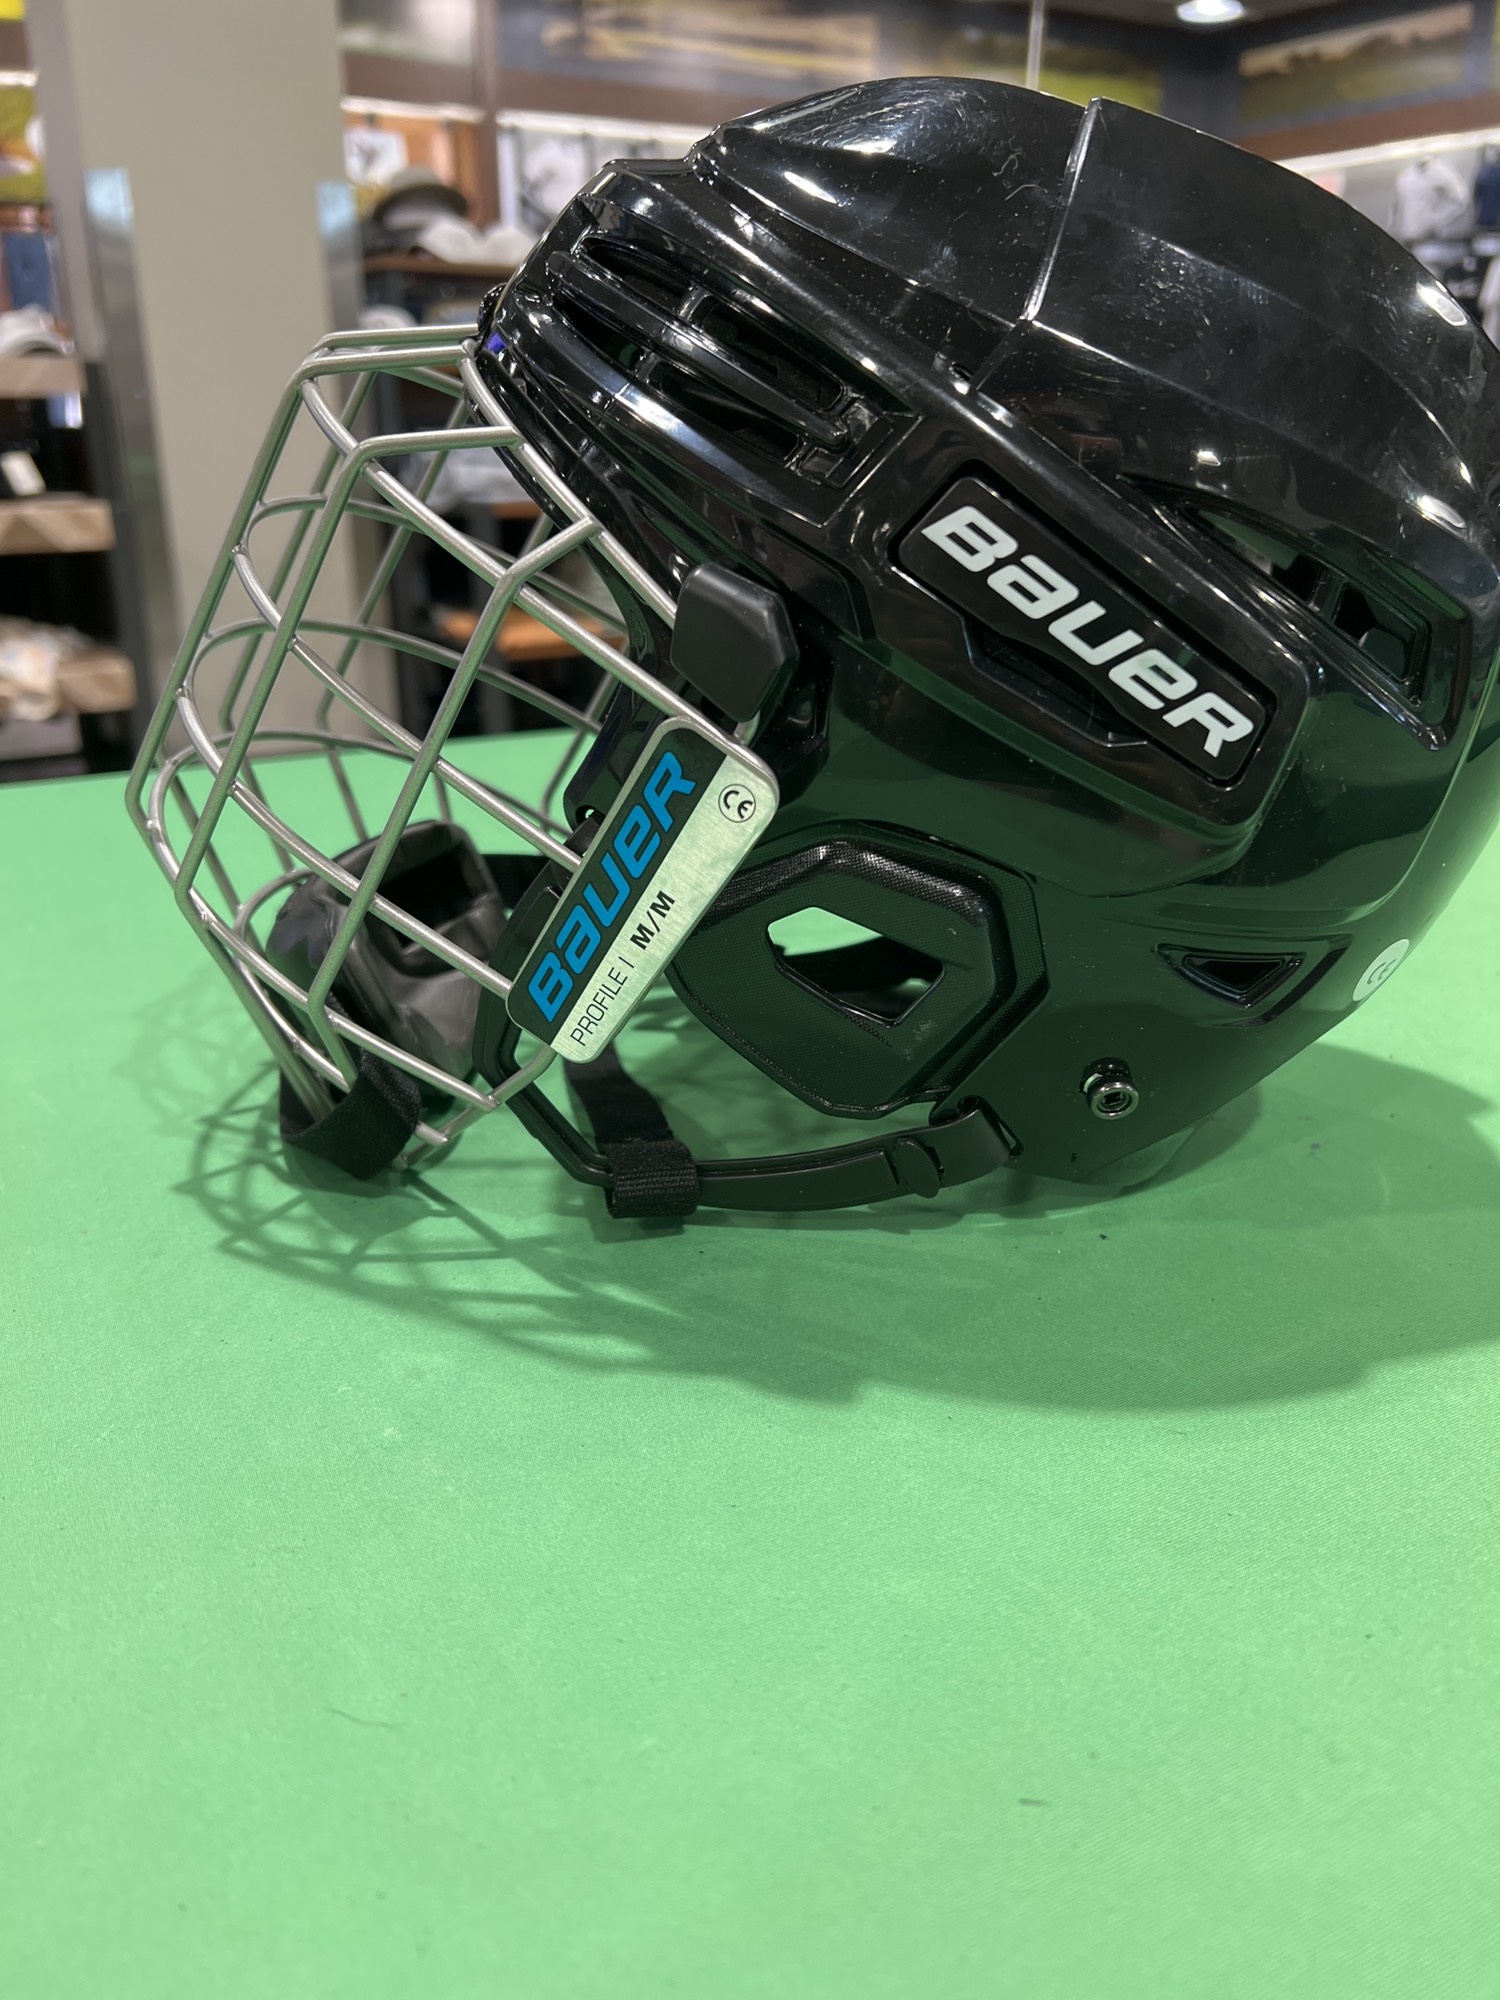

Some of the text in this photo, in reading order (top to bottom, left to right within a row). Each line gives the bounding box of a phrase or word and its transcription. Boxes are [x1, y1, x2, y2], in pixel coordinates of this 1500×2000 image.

[920, 505, 1255, 758] BAUER
[527, 751, 696, 1023] BAUER
[722, 789, 755, 820] CE
[570, 966, 628, 1046] PROFILE
[629, 889, 676, 951] M/M
